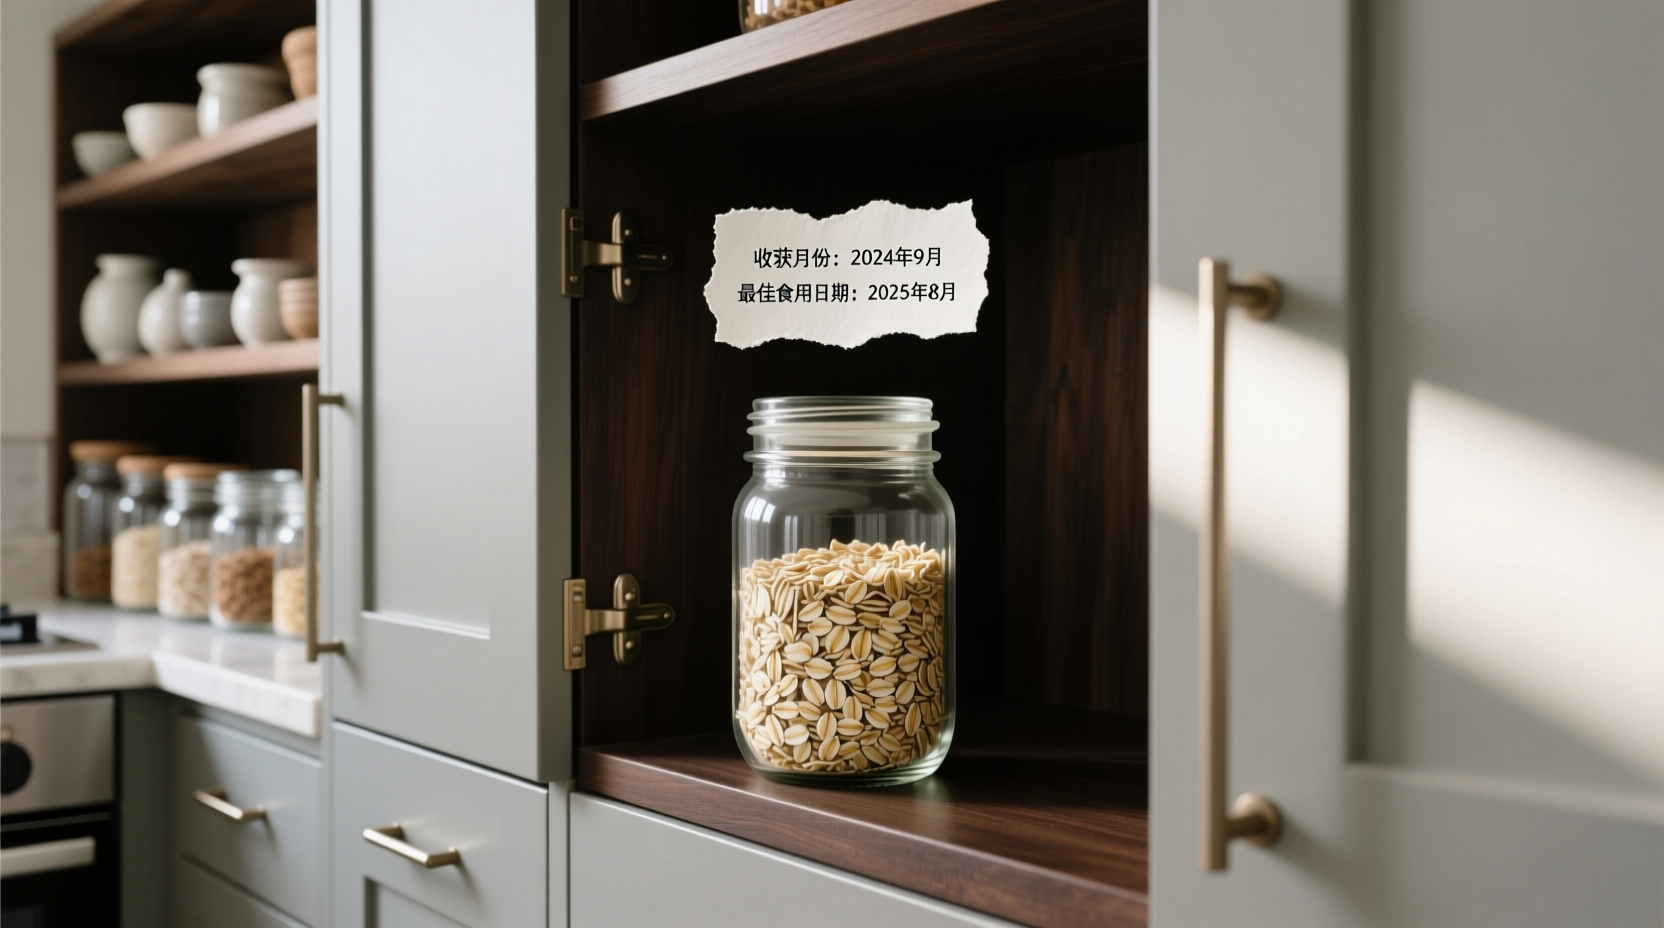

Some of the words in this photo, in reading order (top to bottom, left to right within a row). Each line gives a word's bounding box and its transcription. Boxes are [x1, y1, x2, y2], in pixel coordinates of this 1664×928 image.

[753, 246, 942, 269] 收获月份：2024年9月
[737, 281, 956, 304] 最佳食用日期：2025年8月
